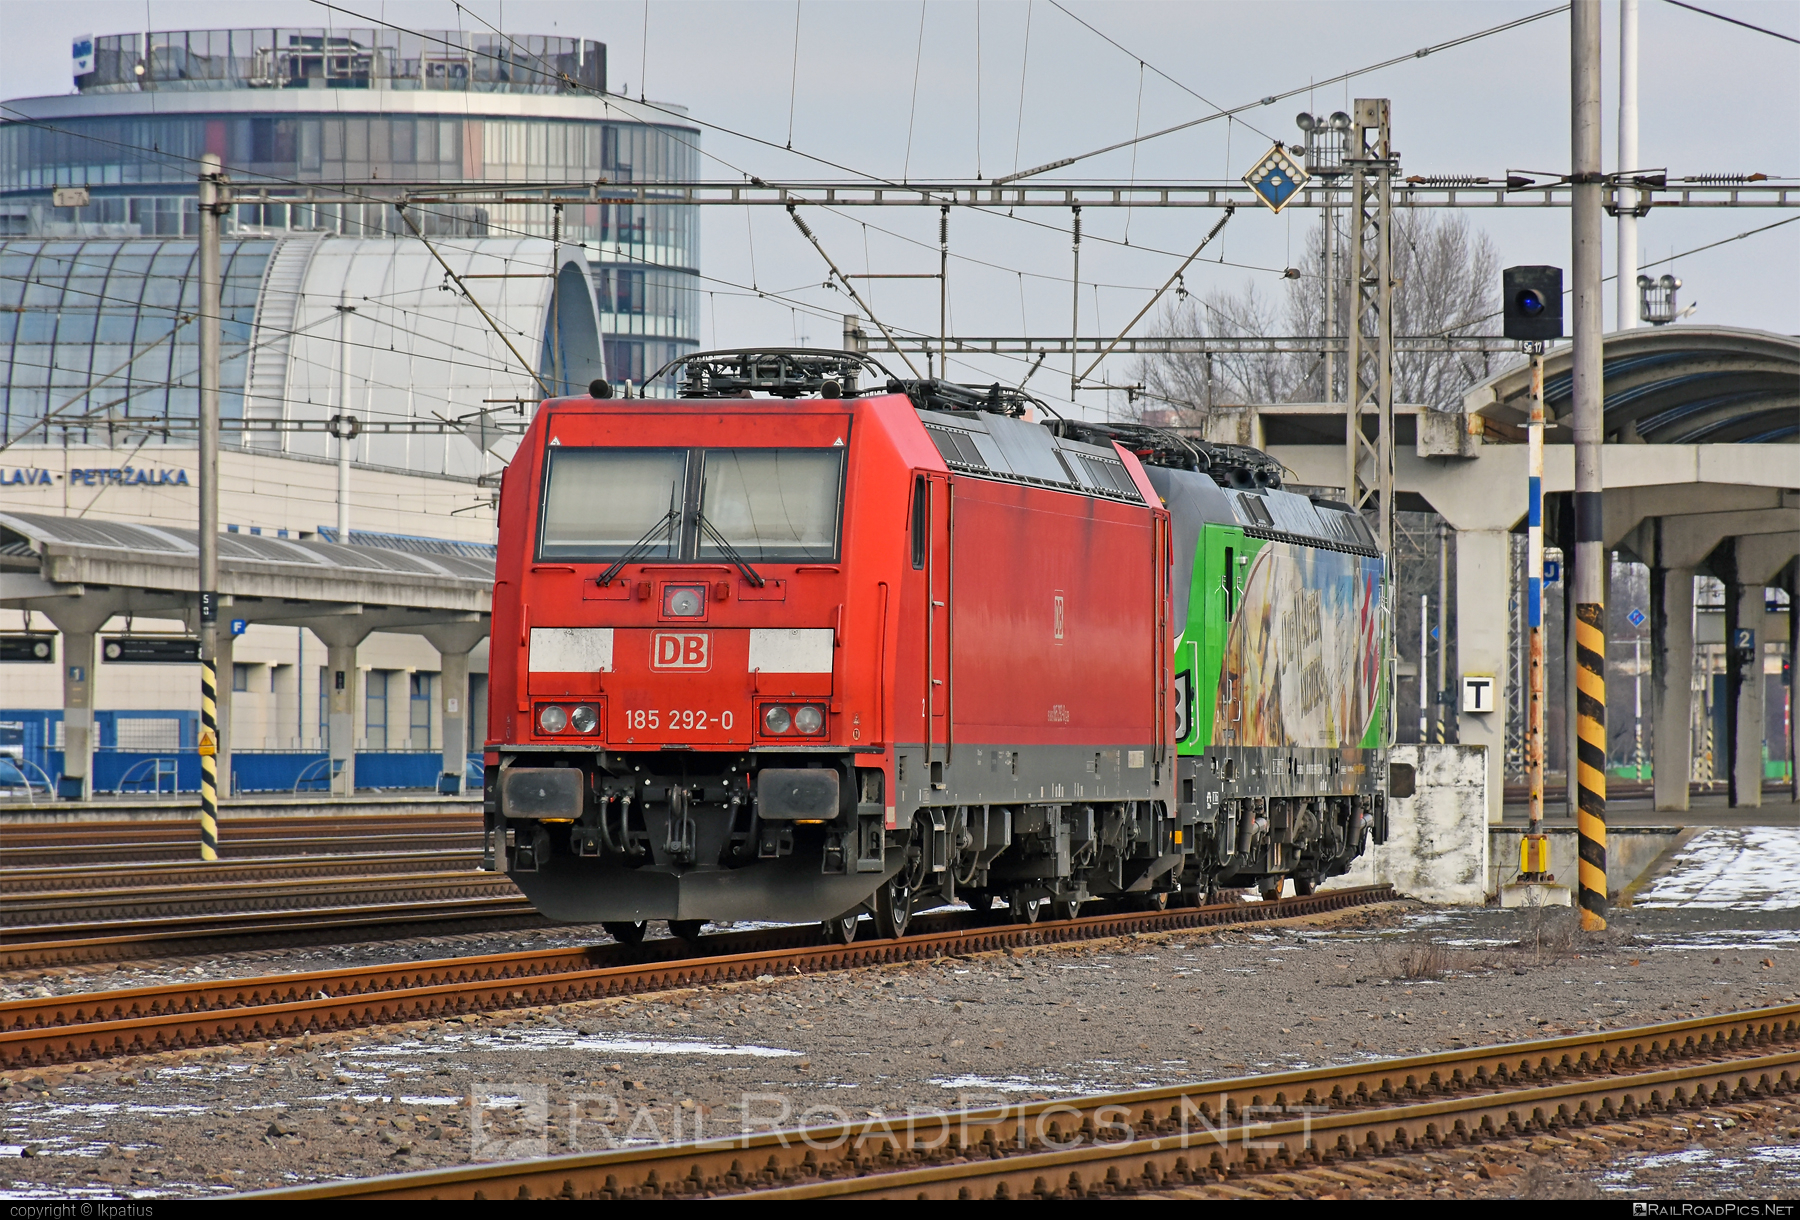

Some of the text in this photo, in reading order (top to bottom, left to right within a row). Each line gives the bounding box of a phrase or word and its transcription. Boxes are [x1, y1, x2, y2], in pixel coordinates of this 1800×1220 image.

[1534, 341, 1543, 353] 17
[71, 465, 190, 487] PETRŽALKA
[1544, 564, 1555, 578] J
[233, 621, 243, 633] F
[1739, 630, 1750, 648] 2
[658, 635, 705, 665] DB
[73, 667, 81, 682] 1
[1466, 681, 1490, 709] T
[625, 709, 734, 730] 185 292-0
